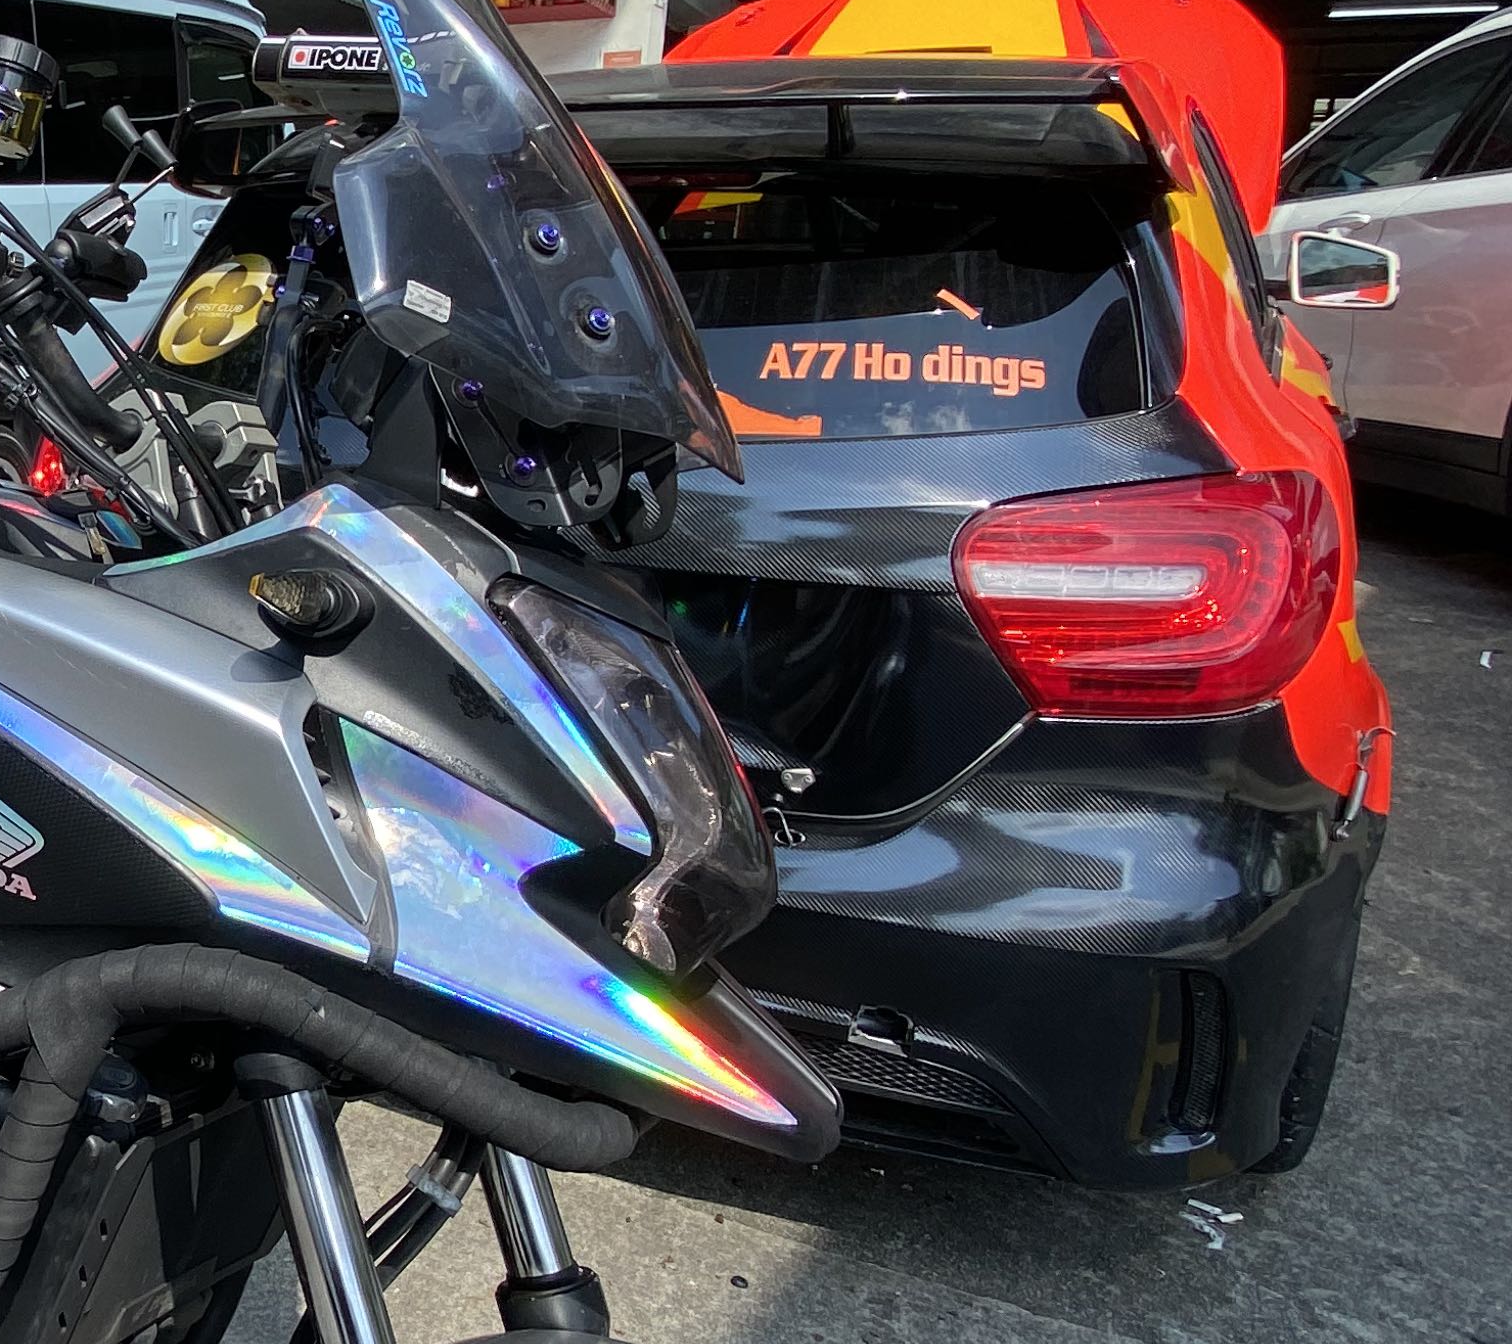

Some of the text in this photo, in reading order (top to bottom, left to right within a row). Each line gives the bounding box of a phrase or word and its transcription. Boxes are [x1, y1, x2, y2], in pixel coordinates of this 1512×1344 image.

[309, 48, 379, 68] IPONE
[217, 304, 245, 313] CLUB
[759, 342, 848, 380] A77
[921, 344, 1046, 397] dings
